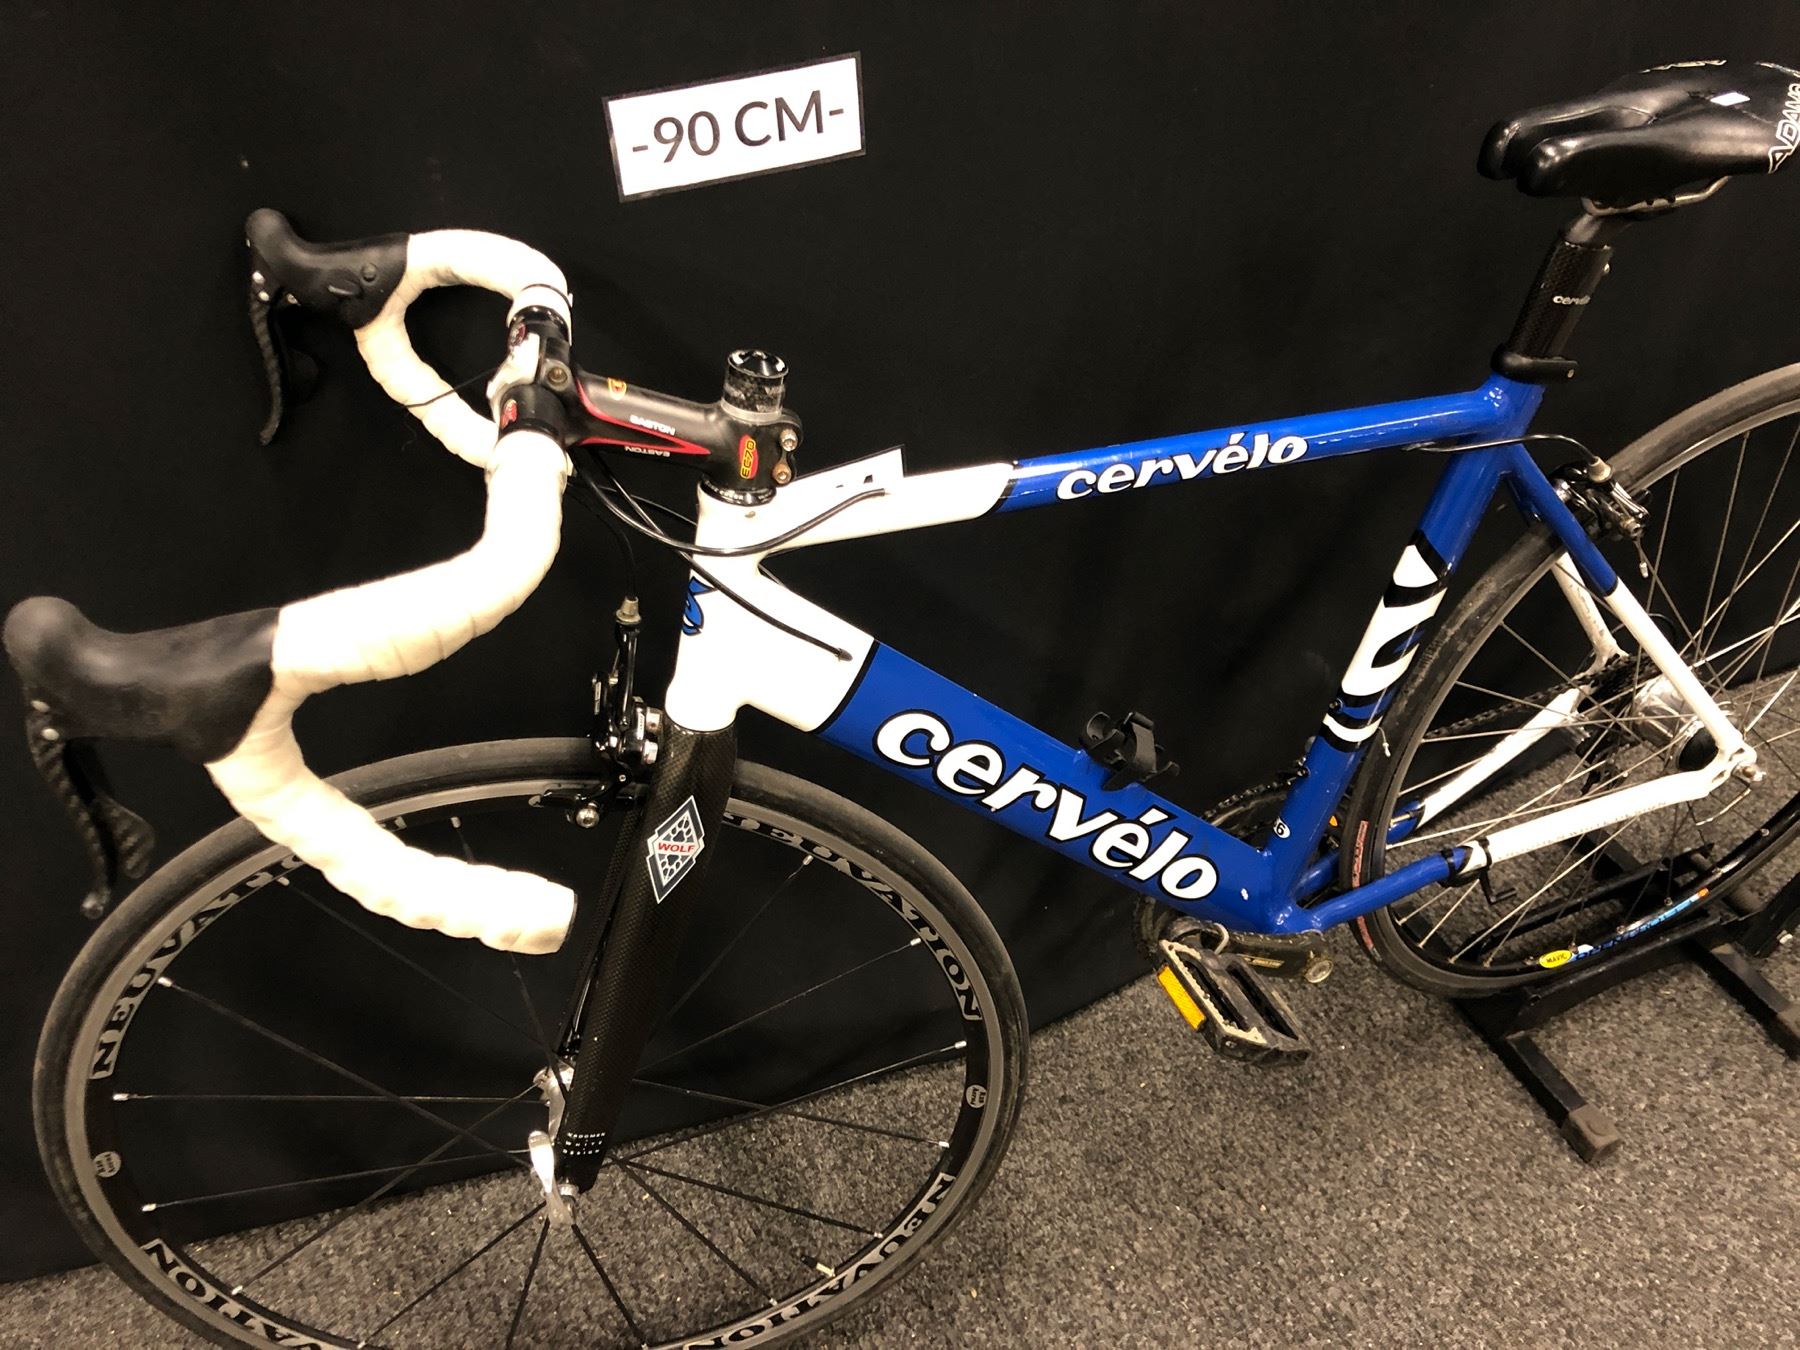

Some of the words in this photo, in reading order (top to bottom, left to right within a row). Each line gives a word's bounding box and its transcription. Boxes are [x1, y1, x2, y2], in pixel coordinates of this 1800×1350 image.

[632, 110, 721, 163] -90
[734, 89, 844, 147] CM-
[624, 445, 671, 458] EASTON
[1056, 431, 1309, 501] cervélo
[873, 708, 1221, 901] cervélo
[657, 842, 696, 853] WOLF
